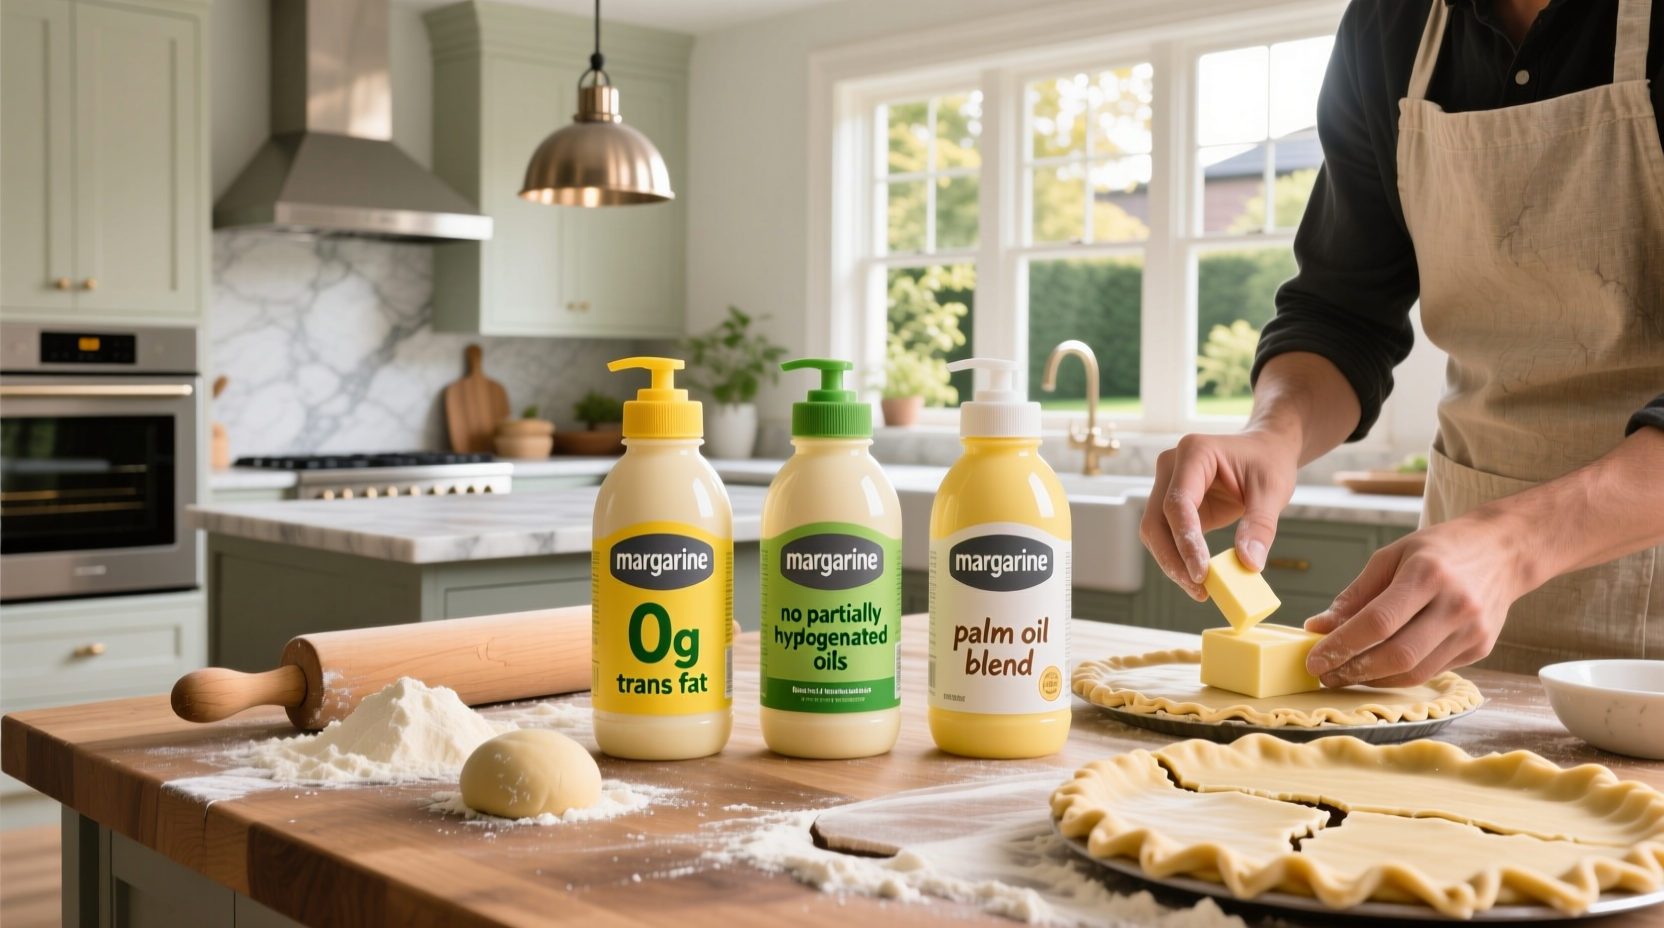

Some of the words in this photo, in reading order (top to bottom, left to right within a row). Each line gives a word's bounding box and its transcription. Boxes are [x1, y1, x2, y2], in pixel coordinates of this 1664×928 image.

[616, 547, 709, 577] margarine
[786, 547, 879, 577] margarine
[955, 547, 1049, 578] margarine
[781, 607, 803, 622] no
[807, 602, 882, 628] partially
[628, 602, 700, 669] 0g
[952, 616, 1015, 651] palm
[1020, 616, 1049, 645] oil
[813, 650, 848, 671] oils
[965, 647, 1034, 677] blend
[616, 673, 673, 694] trans
[678, 671, 708, 694] fat
